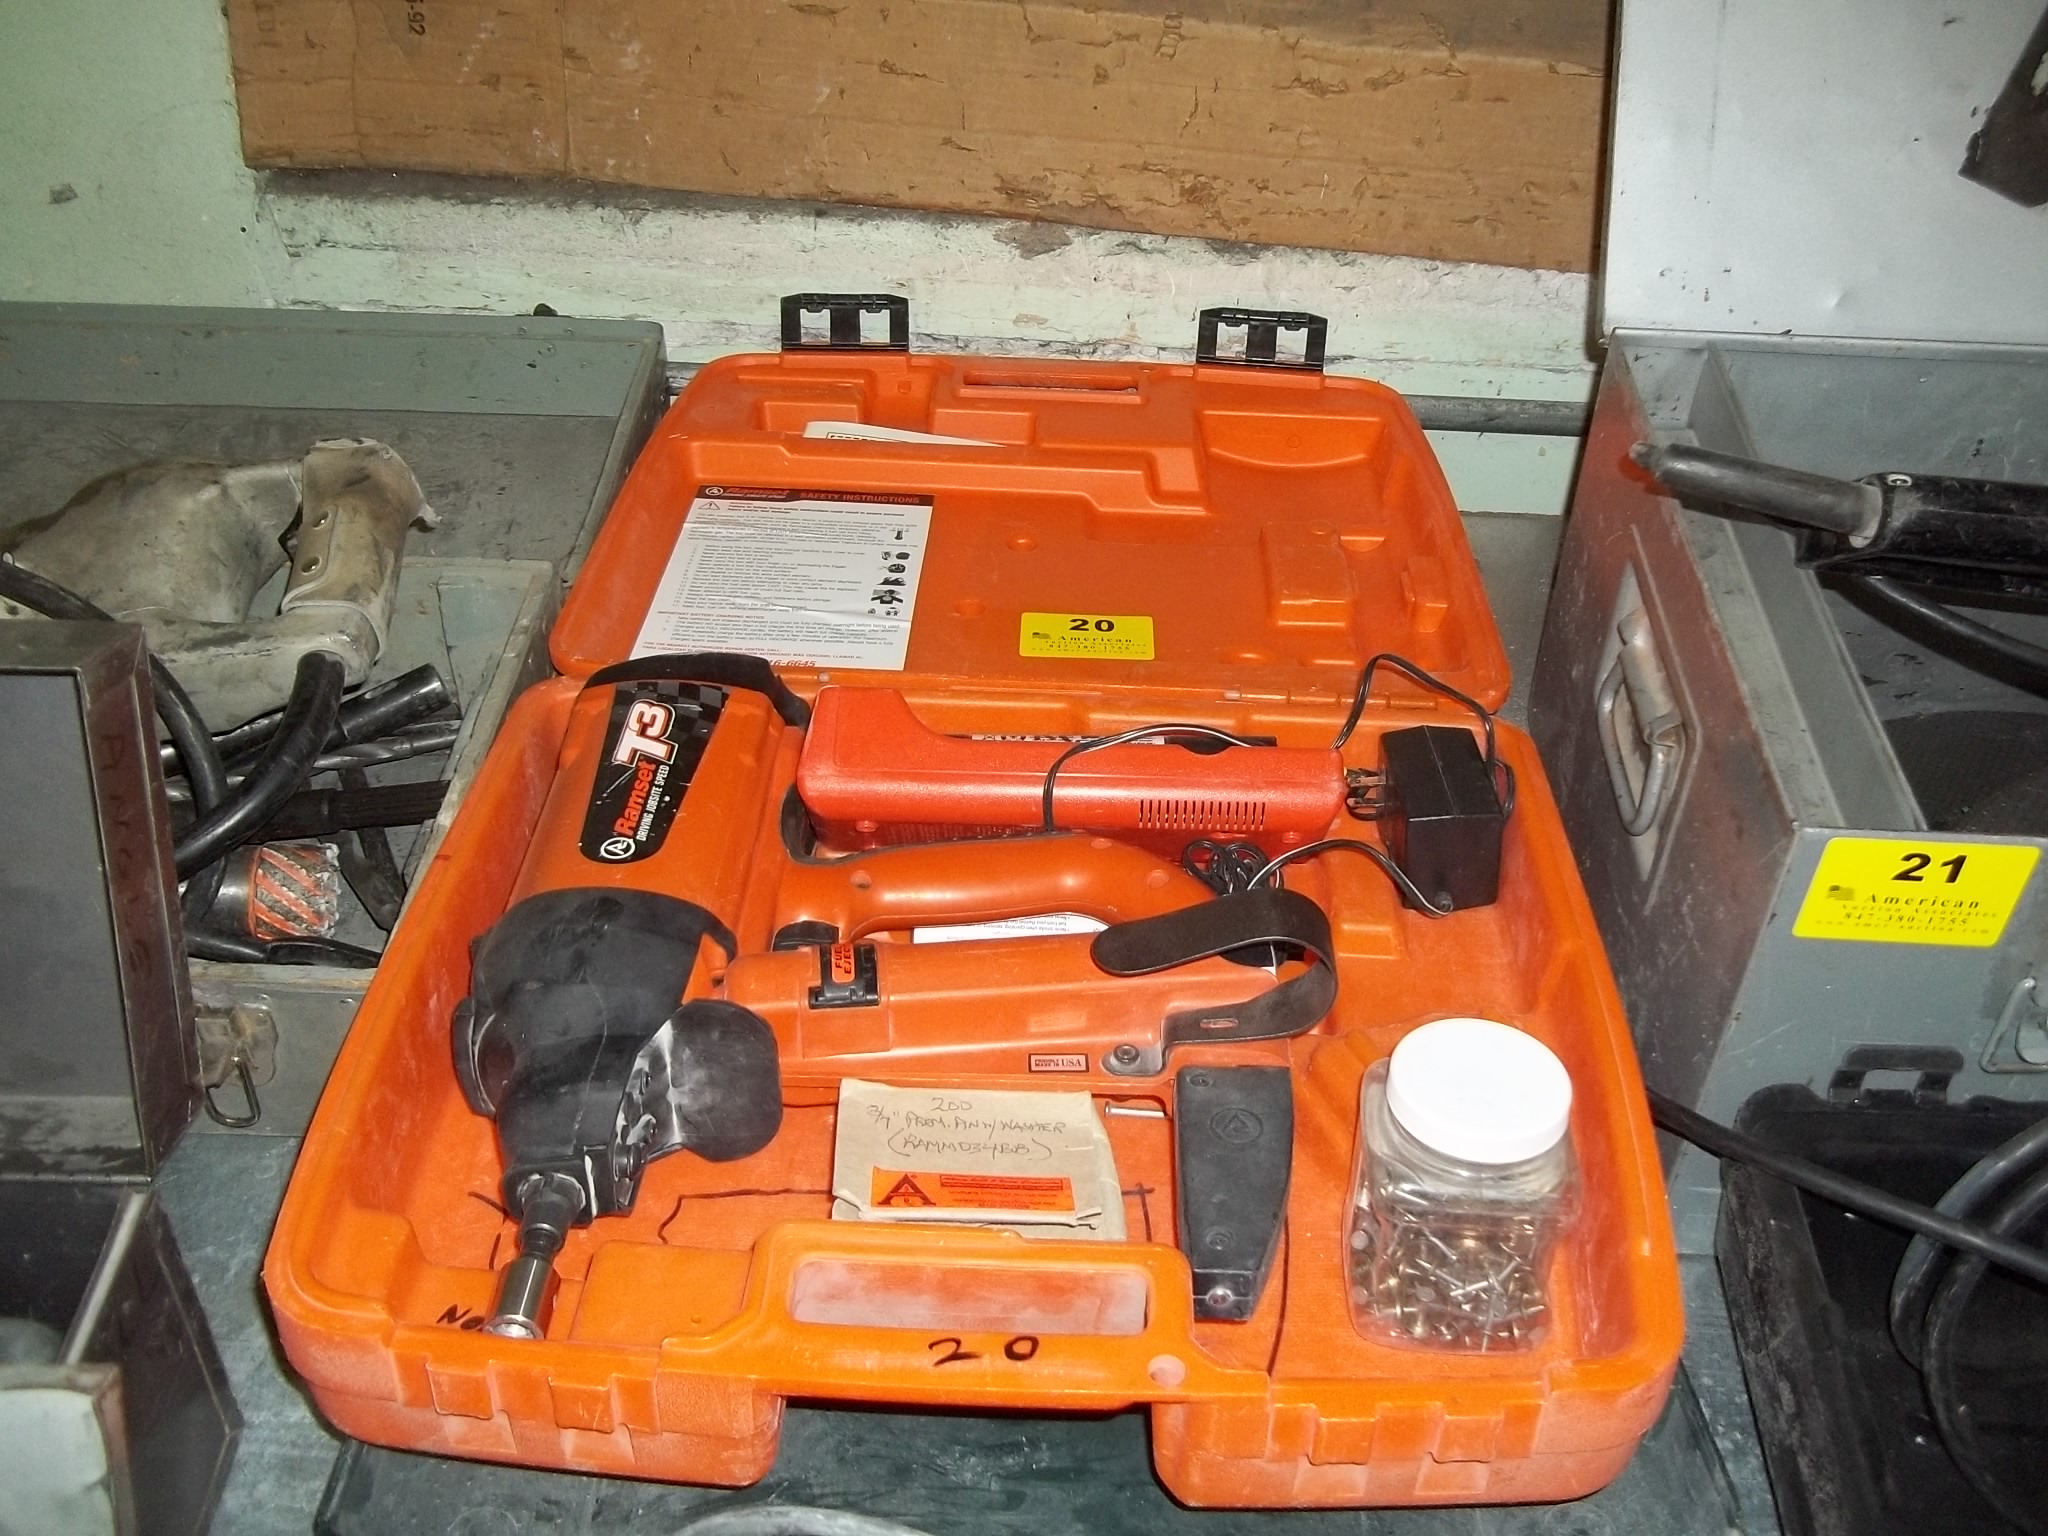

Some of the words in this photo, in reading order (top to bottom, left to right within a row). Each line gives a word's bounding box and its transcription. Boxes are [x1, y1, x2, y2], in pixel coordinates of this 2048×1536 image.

[408, 0, 426, 36] -92
[800, 491, 842, 501] SAFETY
[842, 493, 920, 504] INSTRUCTIONS
[1069, 618, 1115, 632] 20
[769, 659, 816, 667] 16-6645
[613, 699, 678, 767] T3
[654, 764, 670, 786] SPEED
[614, 759, 657, 837] Ramset
[647, 785, 664, 813] JOBSITE
[636, 812, 654, 842] DRIVING
[1891, 852, 1968, 884] 21
[1864, 893, 1980, 909] American
[1061, 1058, 1082, 1067] USA
[931, 1097, 973, 1112] 200
[928, 1335, 1040, 1367] 20
